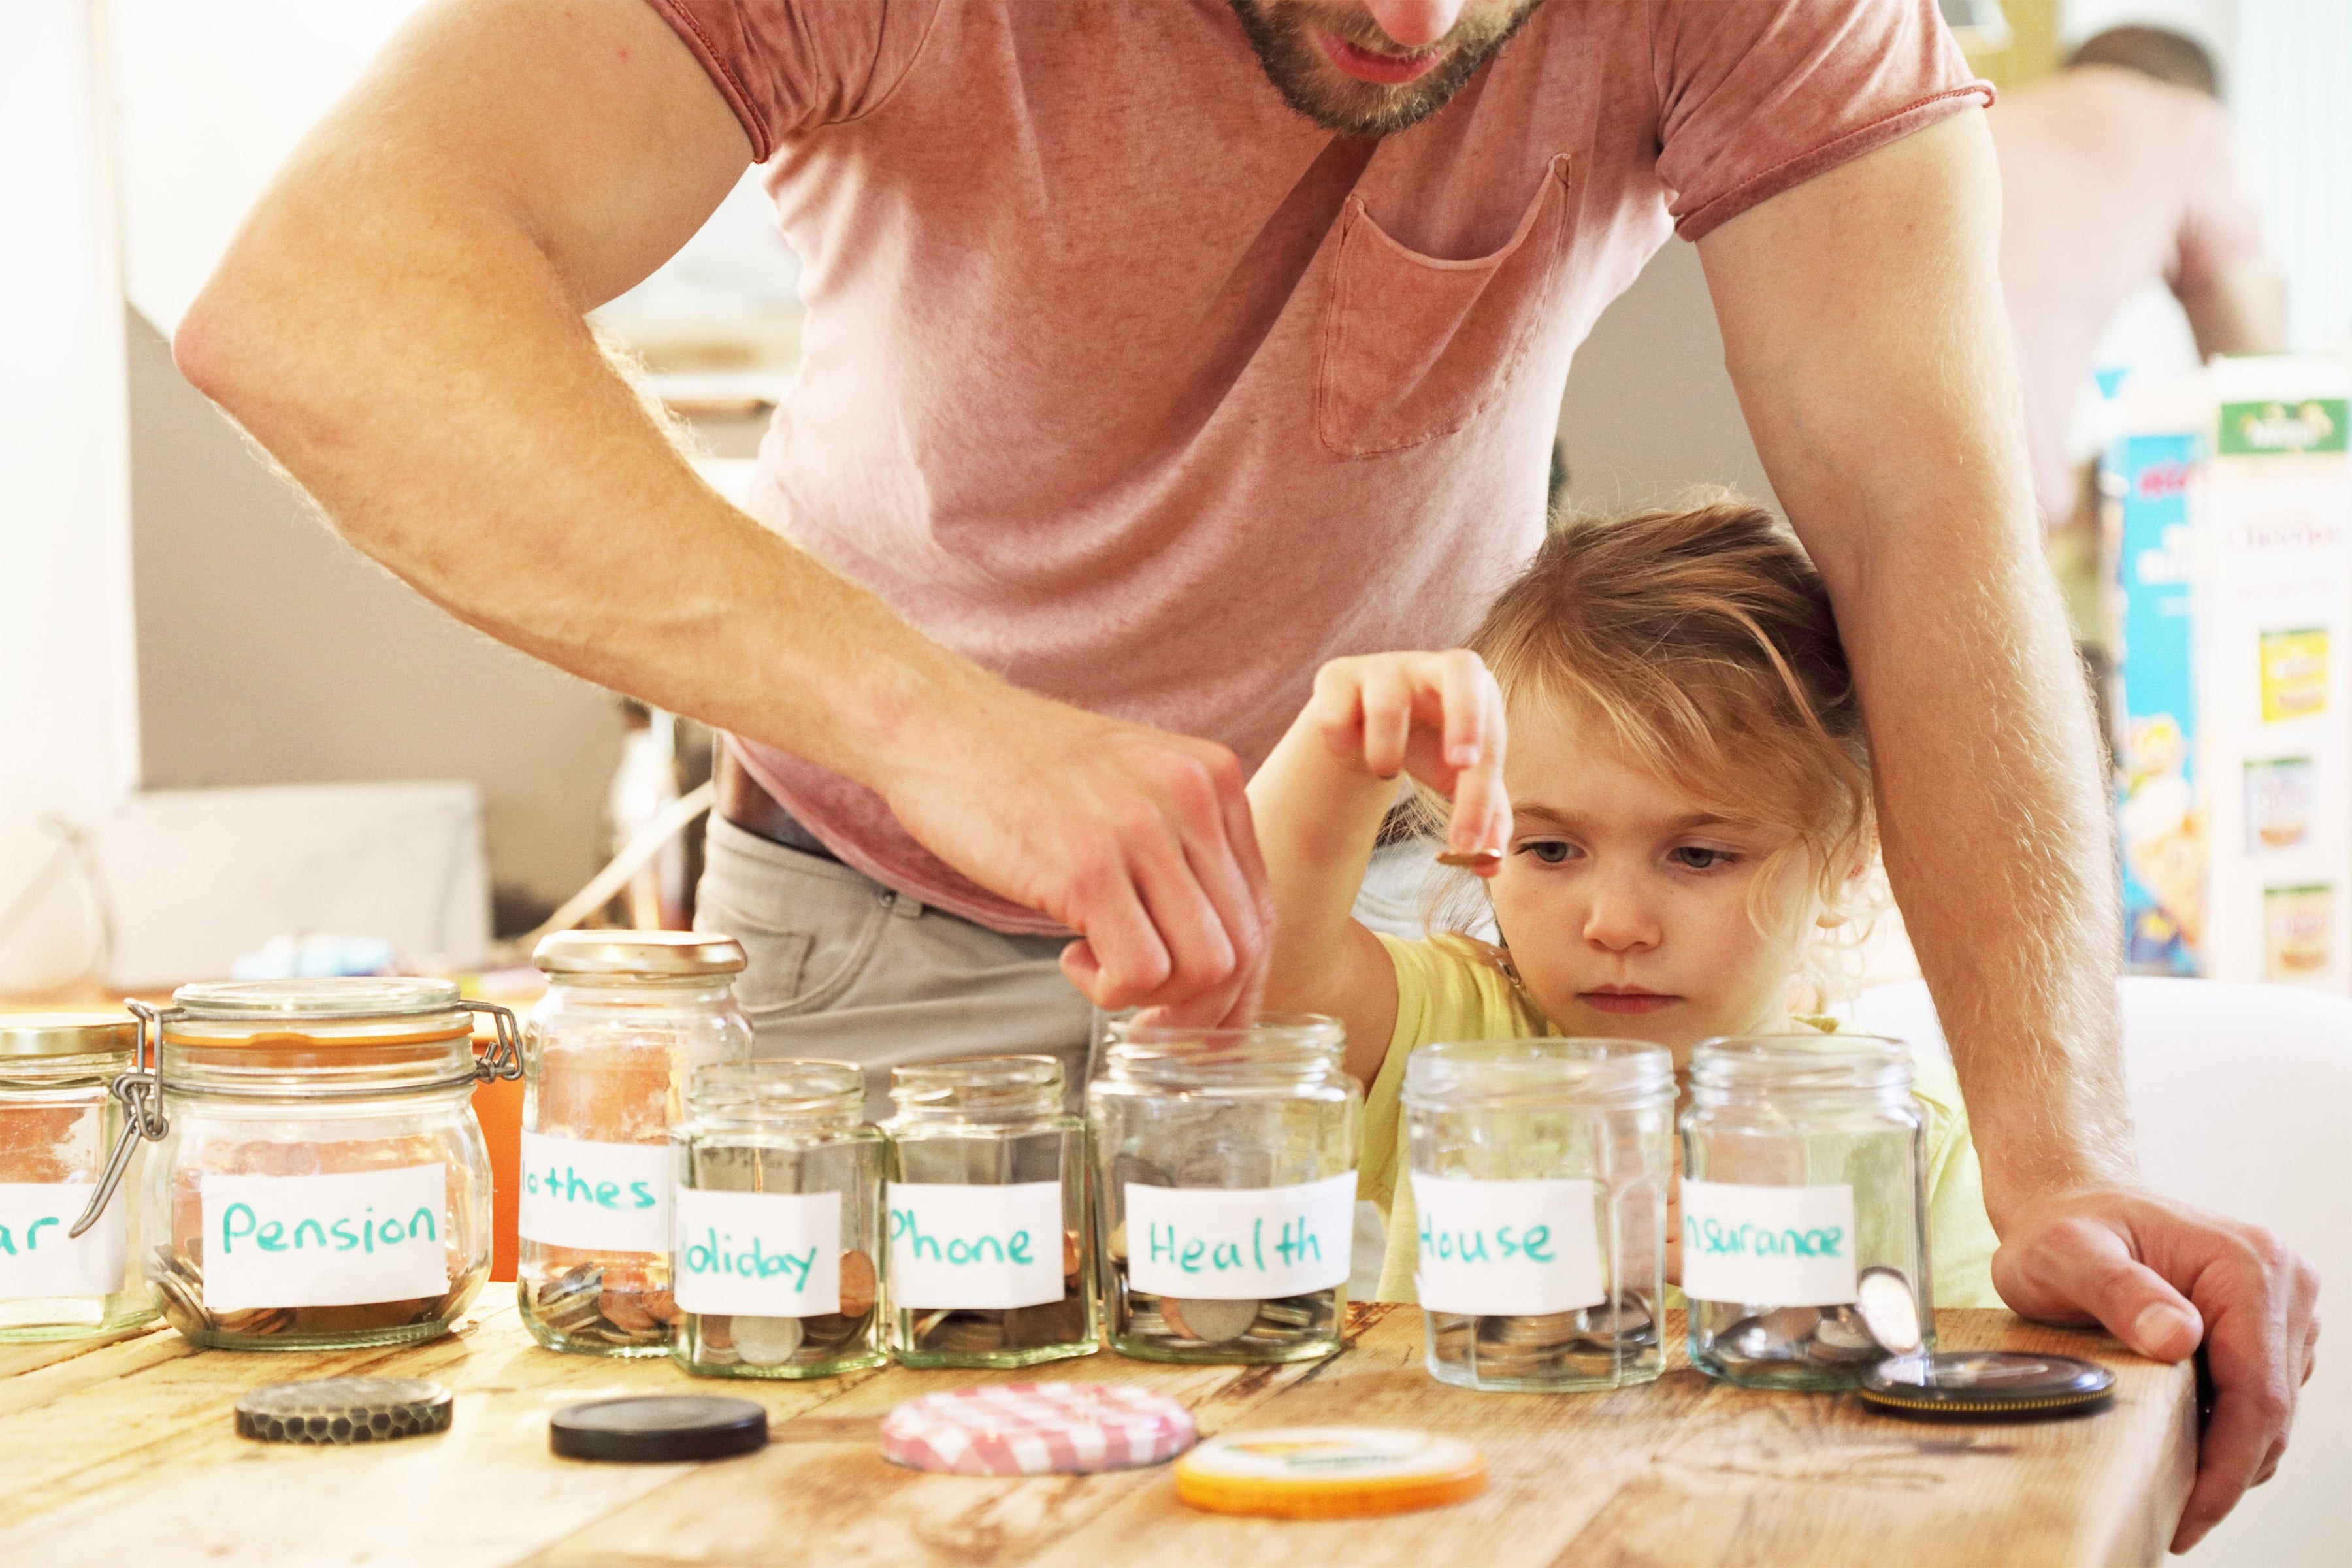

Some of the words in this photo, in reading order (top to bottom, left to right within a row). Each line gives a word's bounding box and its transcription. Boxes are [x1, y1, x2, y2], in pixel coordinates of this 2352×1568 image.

[222, 1201, 436, 1254] Pension
[889, 1209, 1034, 1266] Phone
[1150, 1215, 1322, 1274] Health
[679, 1227, 817, 1294] oliday
